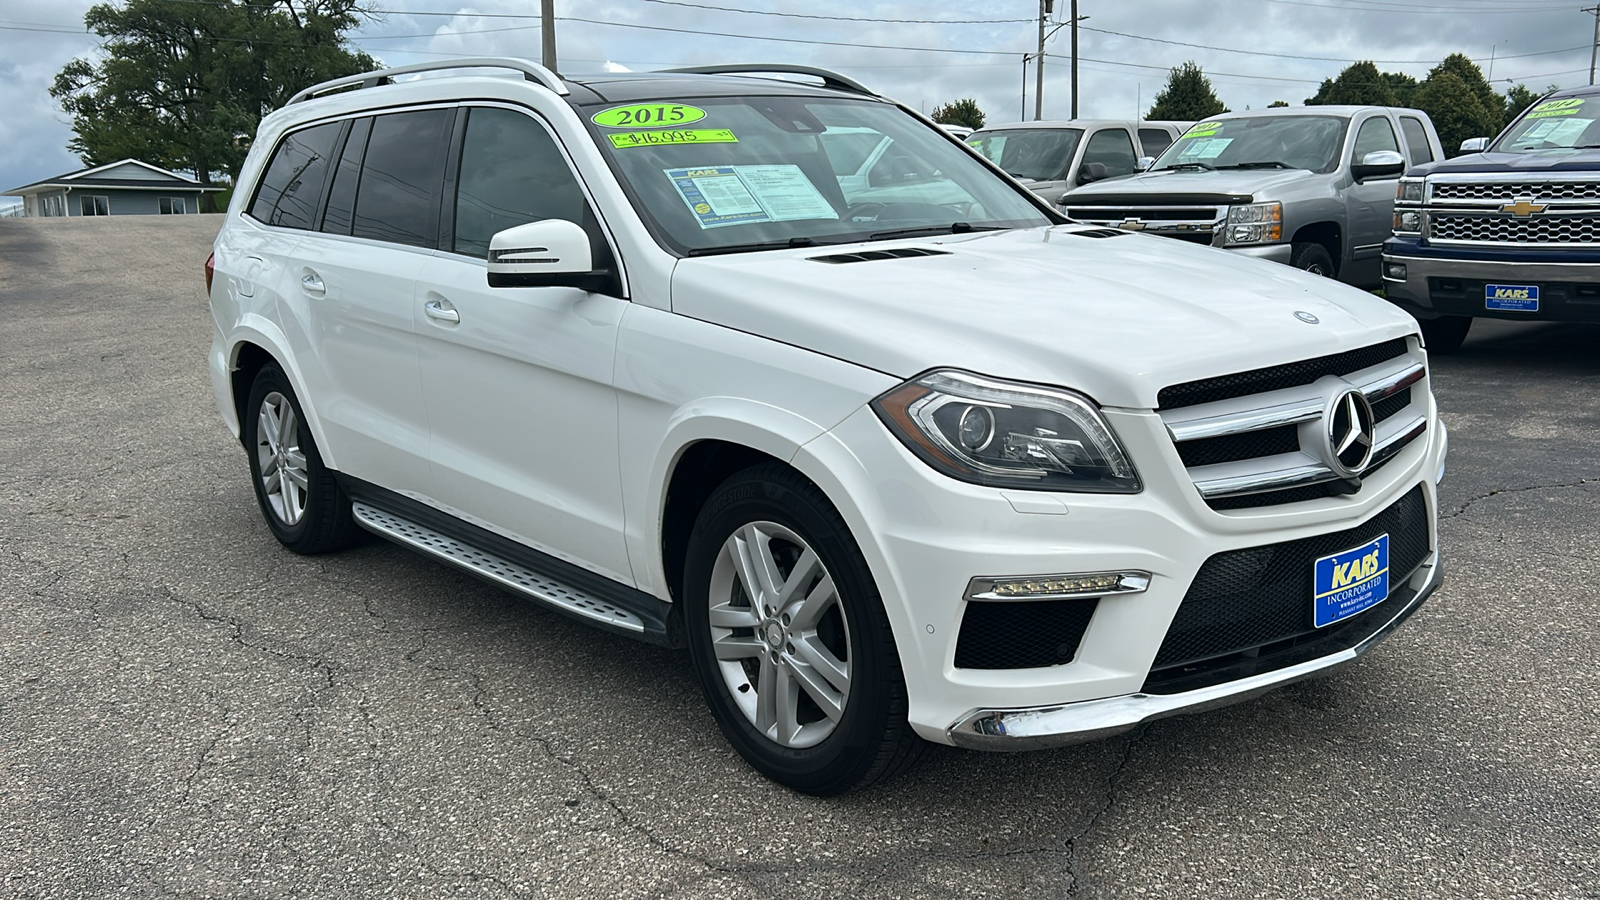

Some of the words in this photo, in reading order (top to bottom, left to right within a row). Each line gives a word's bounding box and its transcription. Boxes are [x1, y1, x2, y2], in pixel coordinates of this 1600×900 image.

[617, 107, 684, 125] 2015
[628, 130, 697, 144] $16,995
[687, 169, 719, 177] KARS
[1495, 288, 1529, 299] KARS
[1331, 549, 1379, 589] KARS
[1327, 576, 1382, 605] INCORPORATED
